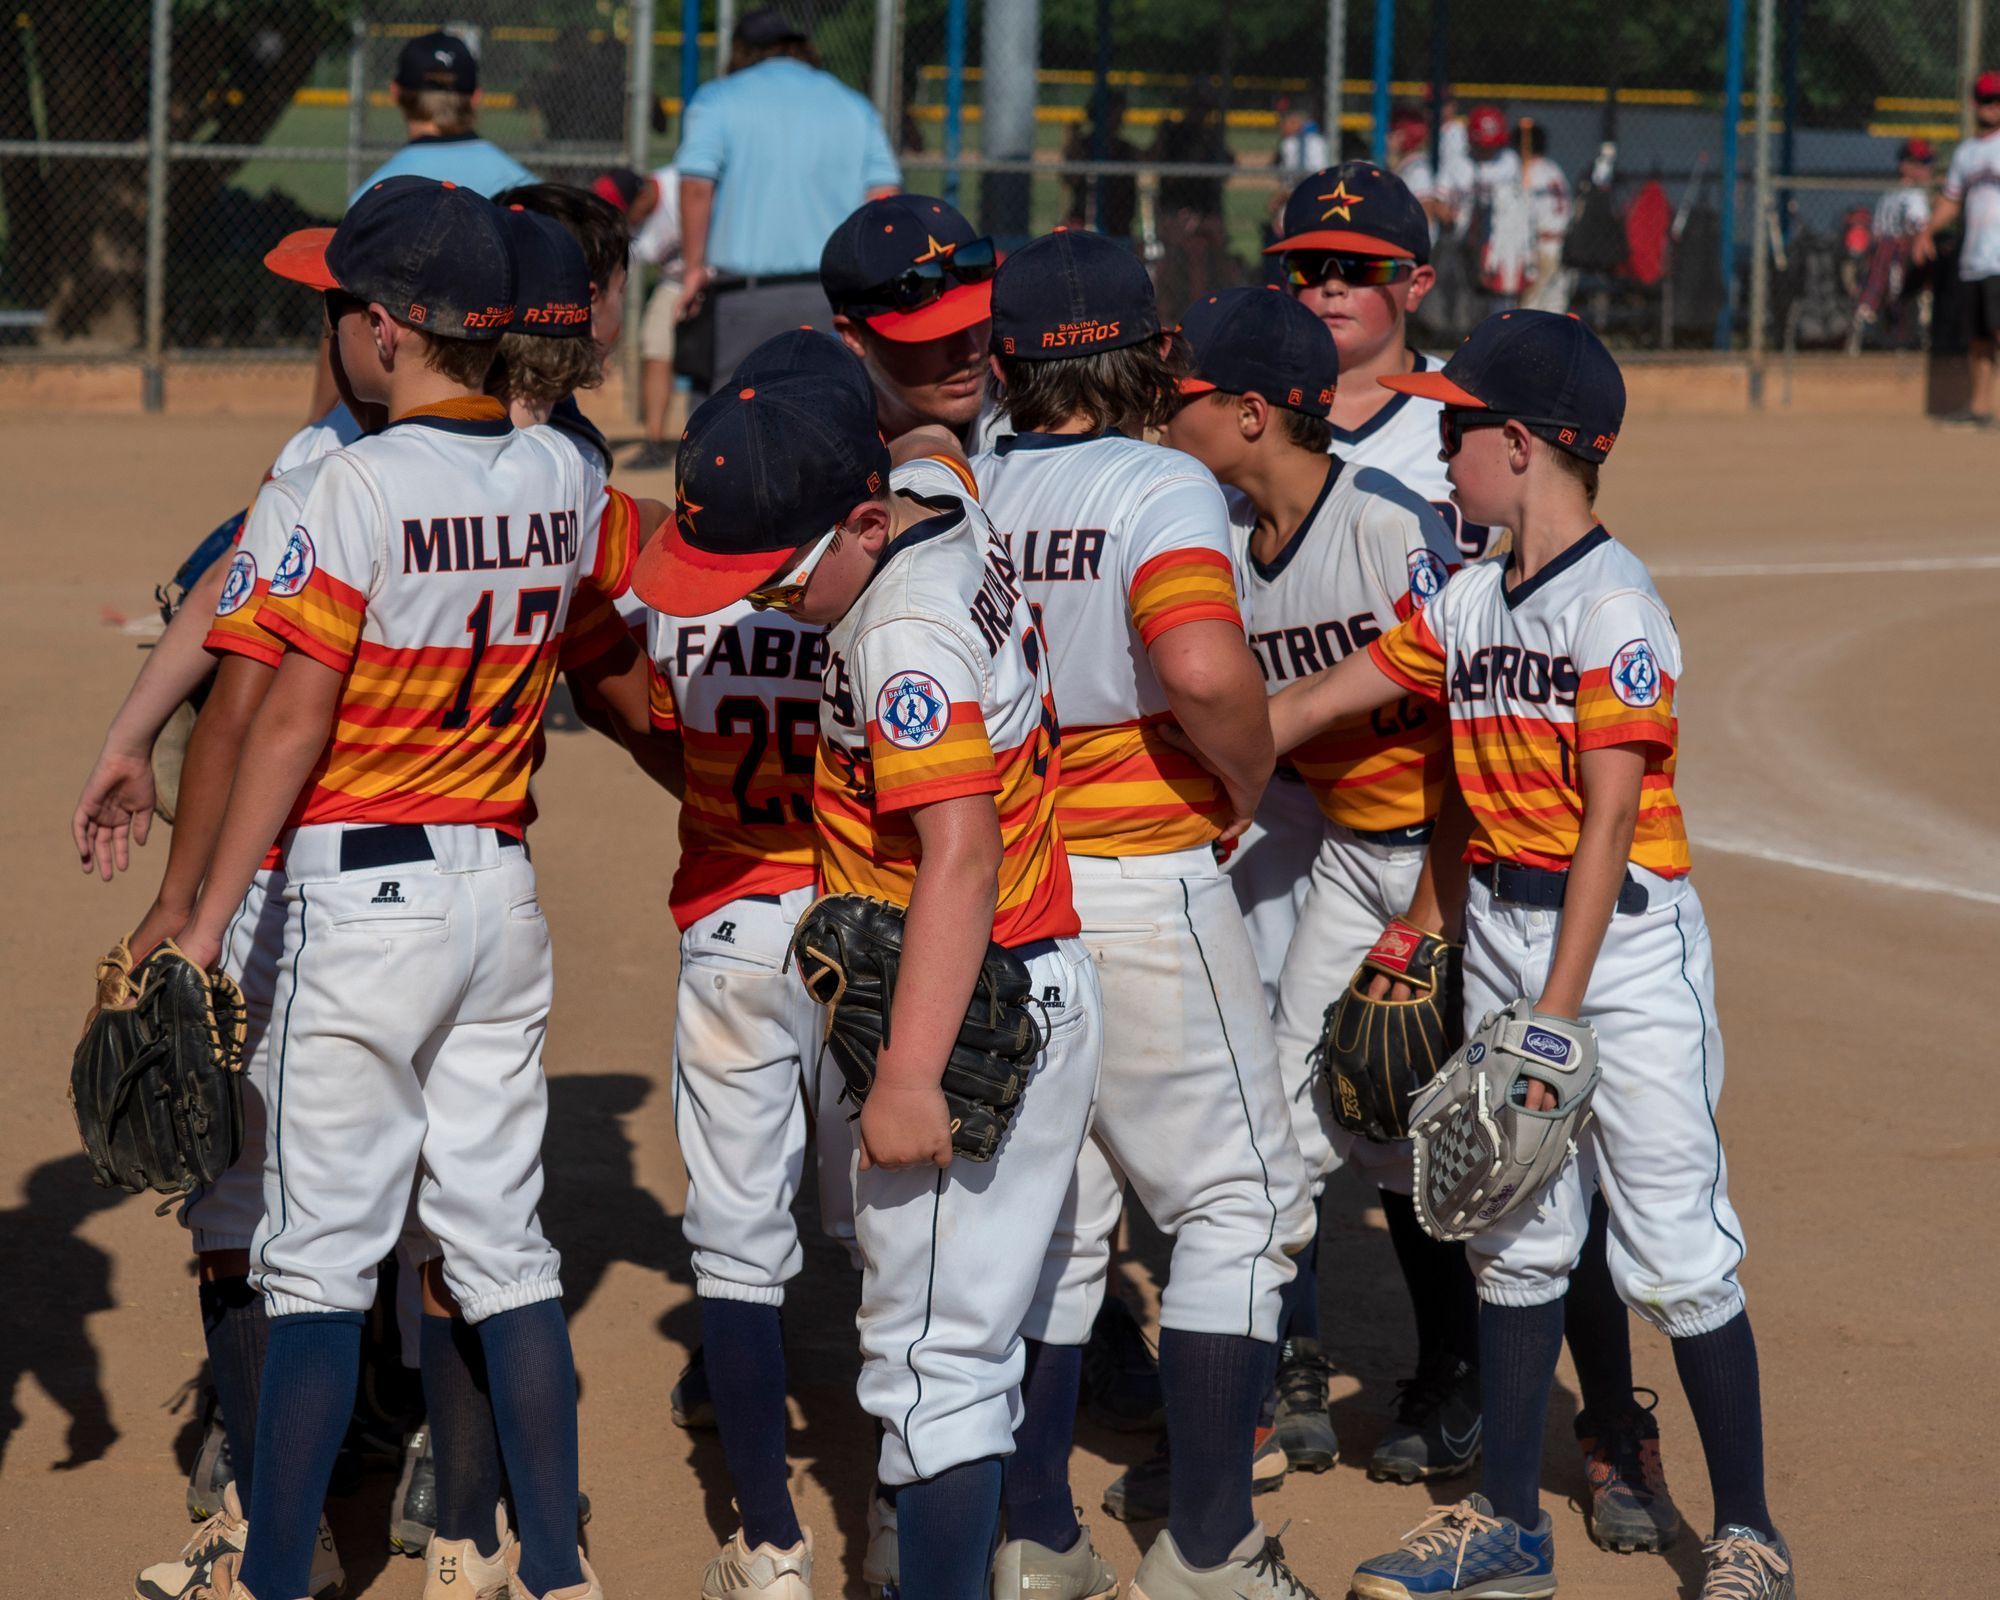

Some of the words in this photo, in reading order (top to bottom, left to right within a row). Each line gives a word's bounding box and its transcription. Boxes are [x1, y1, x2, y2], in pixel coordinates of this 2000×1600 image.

[524, 307, 589, 325] ASTROS
[1059, 320, 1099, 332] SALINA
[1041, 321, 1121, 349] ASTROS
[402, 510, 578, 574] MILLARD
[437, 585, 562, 732] 17
[889, 689, 907, 698] BABE
[908, 685, 928, 694] RUTH
[898, 725, 932, 736] BASEBALL
[714, 695, 821, 825] 25
